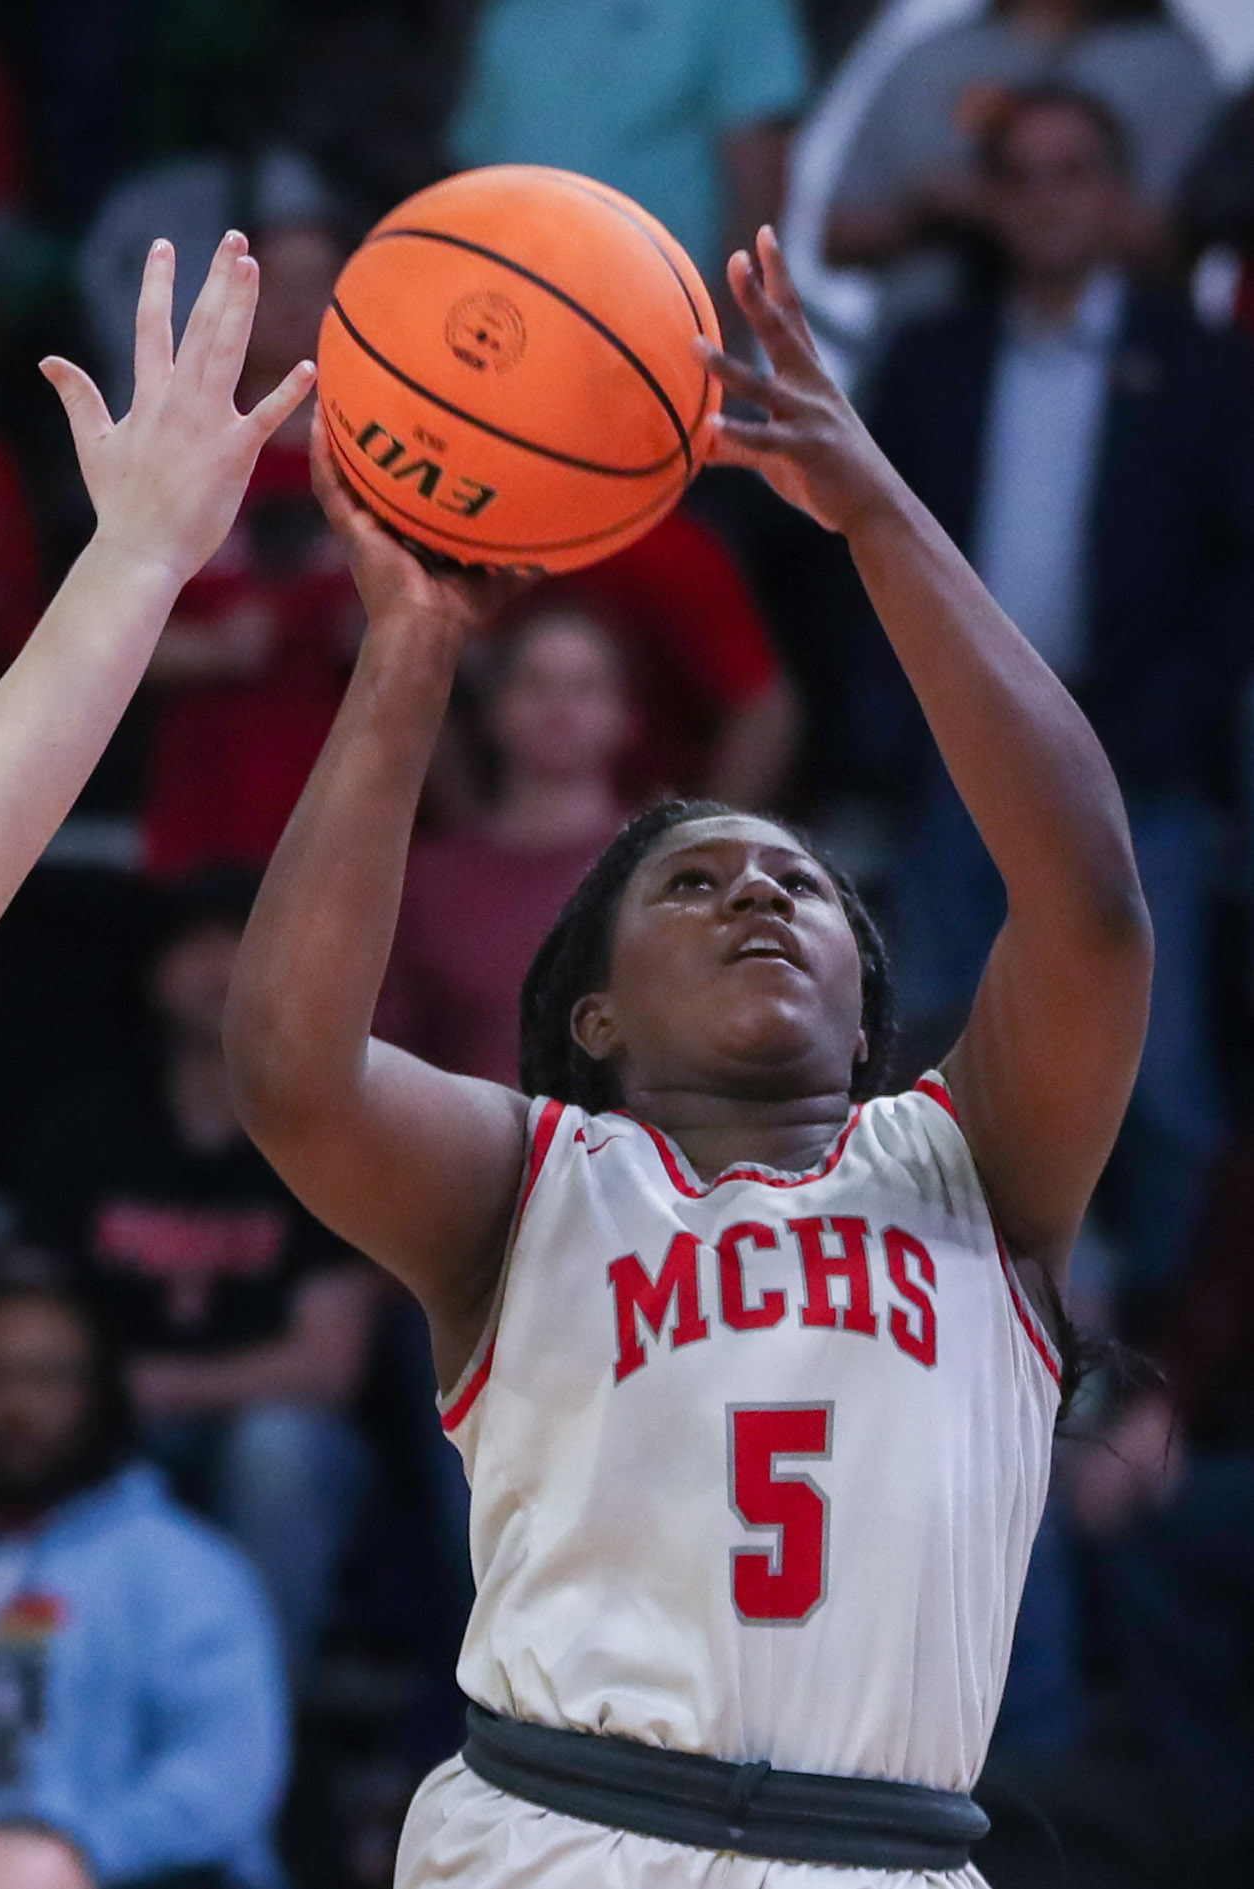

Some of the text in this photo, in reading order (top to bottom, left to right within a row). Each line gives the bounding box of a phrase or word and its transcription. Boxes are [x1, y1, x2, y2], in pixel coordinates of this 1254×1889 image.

[356, 420, 496, 517] EVO
[606, 1214, 937, 1388] MCHS
[725, 1400, 835, 1628] 5
